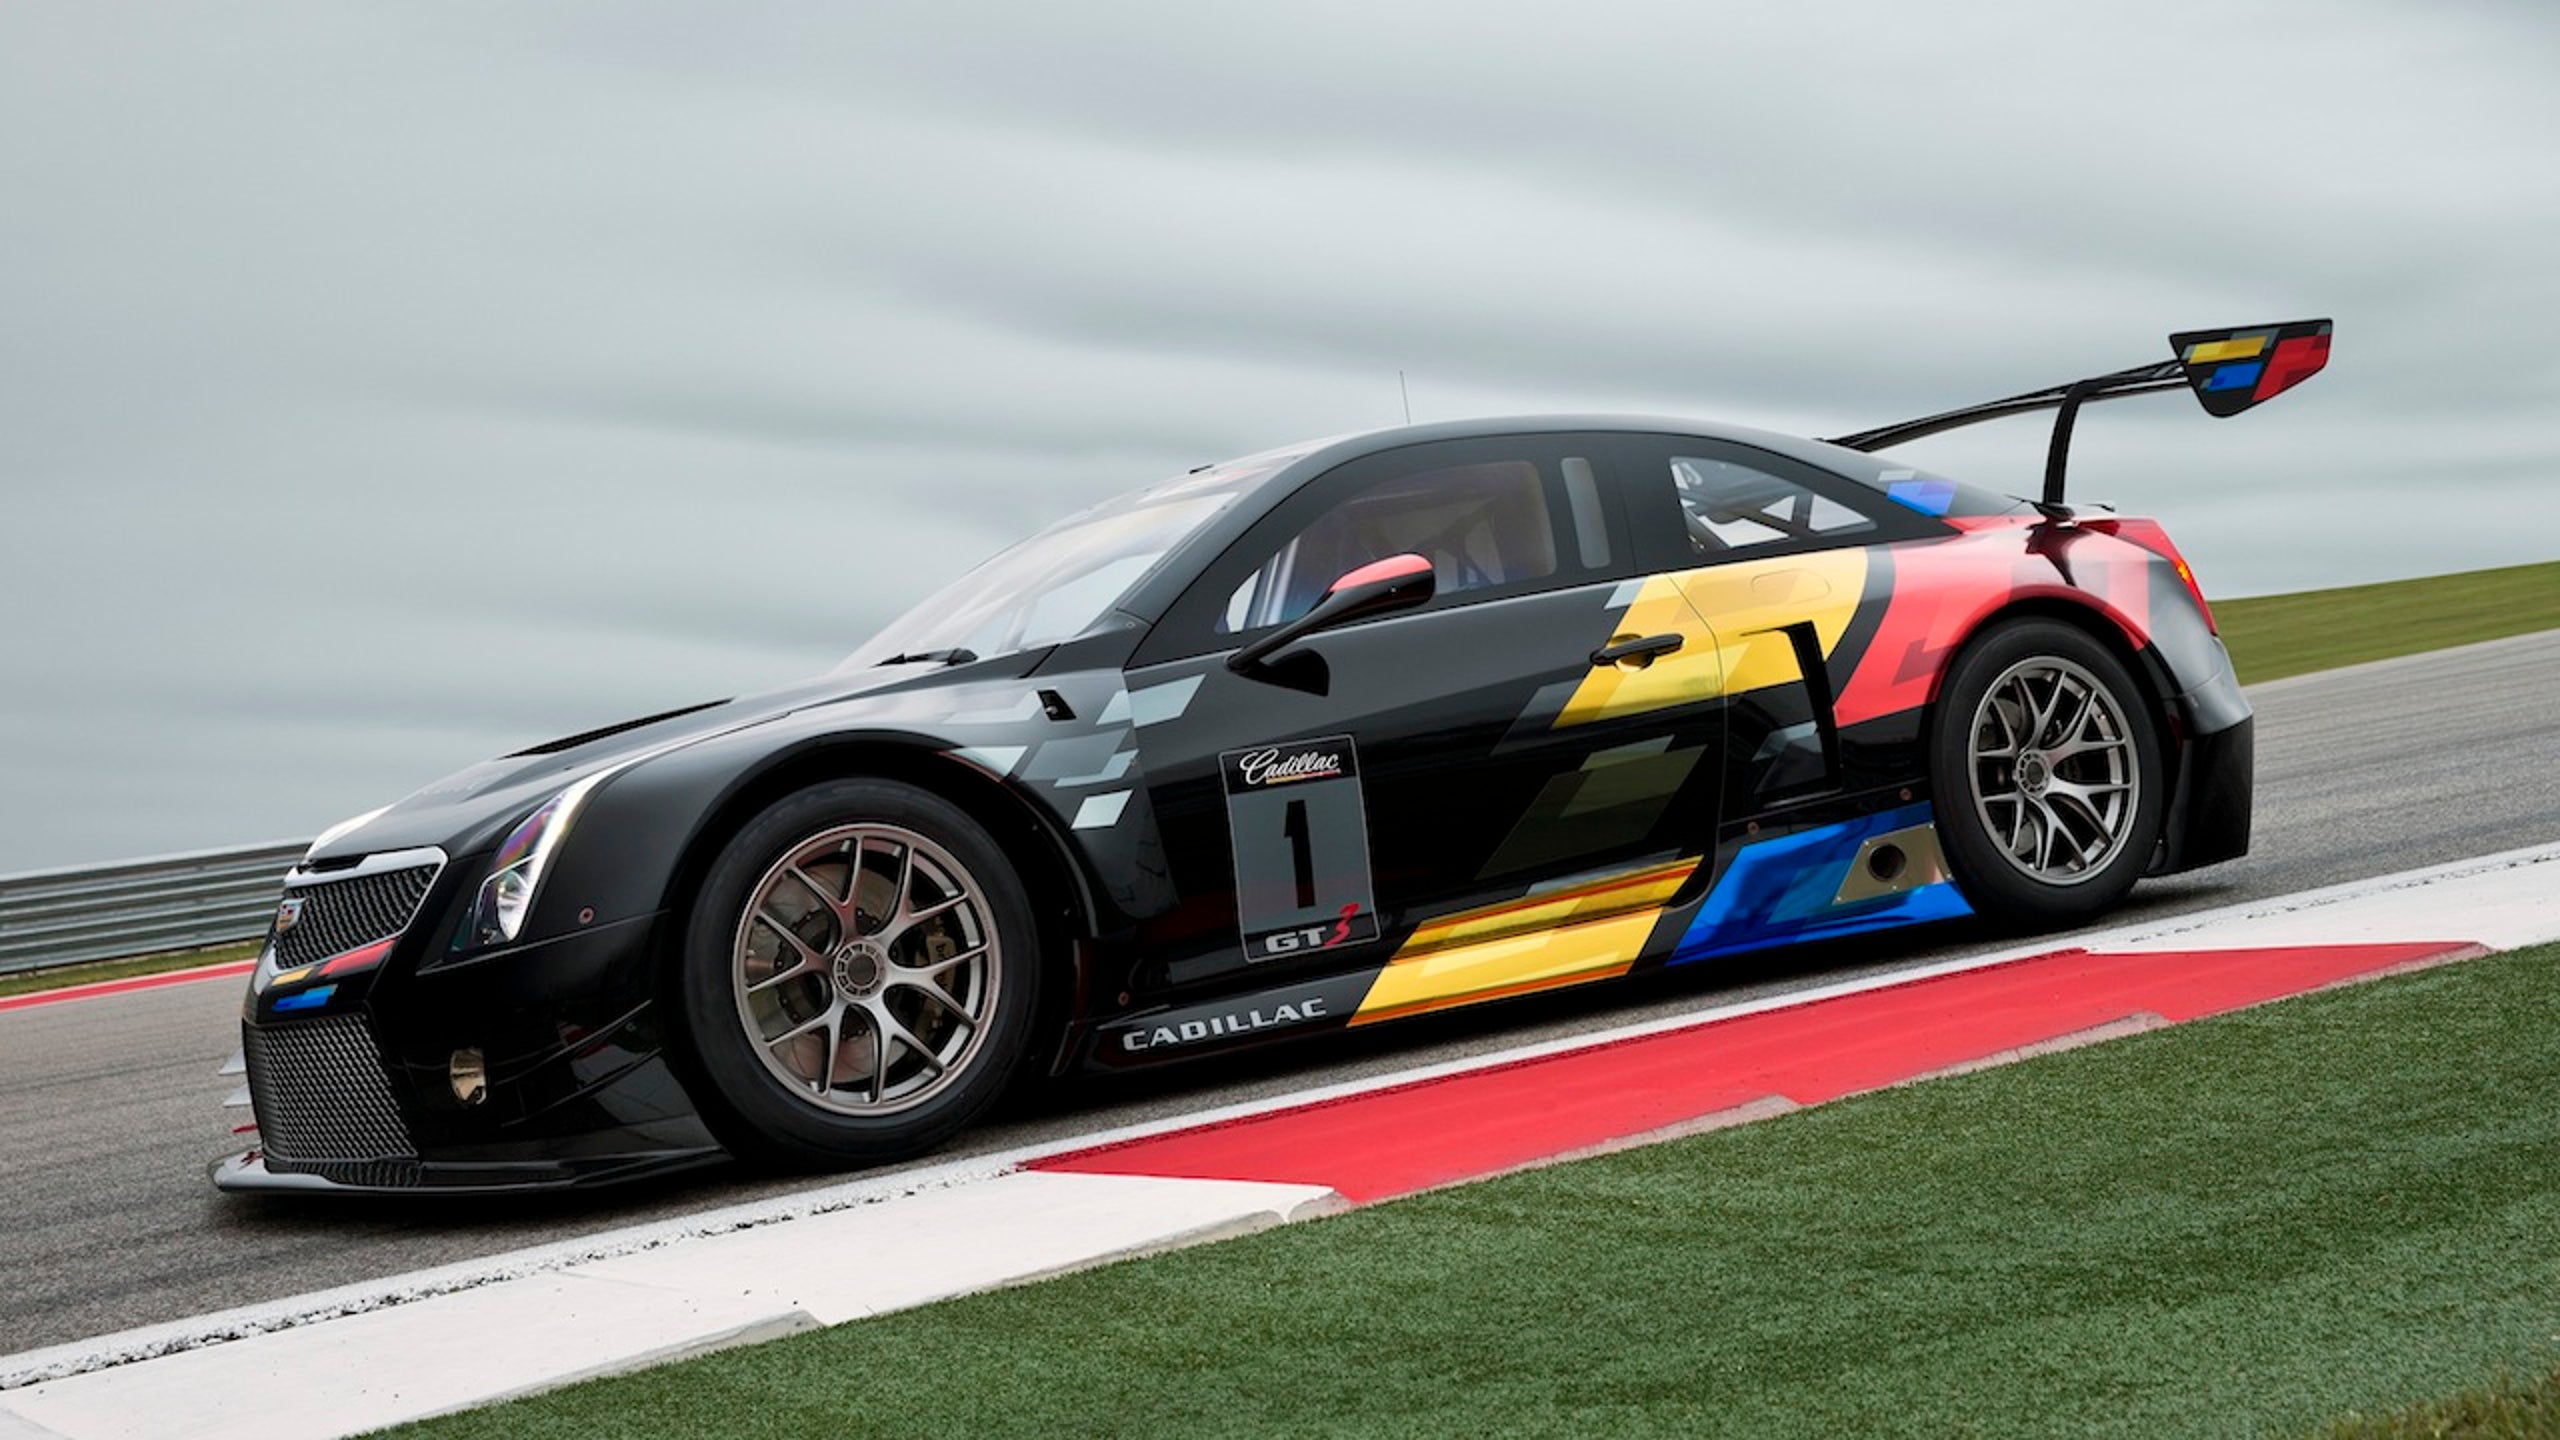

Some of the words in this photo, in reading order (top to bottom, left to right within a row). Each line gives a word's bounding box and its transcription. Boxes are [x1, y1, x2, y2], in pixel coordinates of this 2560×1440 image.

[1240, 748, 1339, 785] Cadillac
[1284, 799, 1316, 910] 1
[1265, 902, 1360, 953] GT3
[1123, 998, 1328, 1051] CADILLAC
